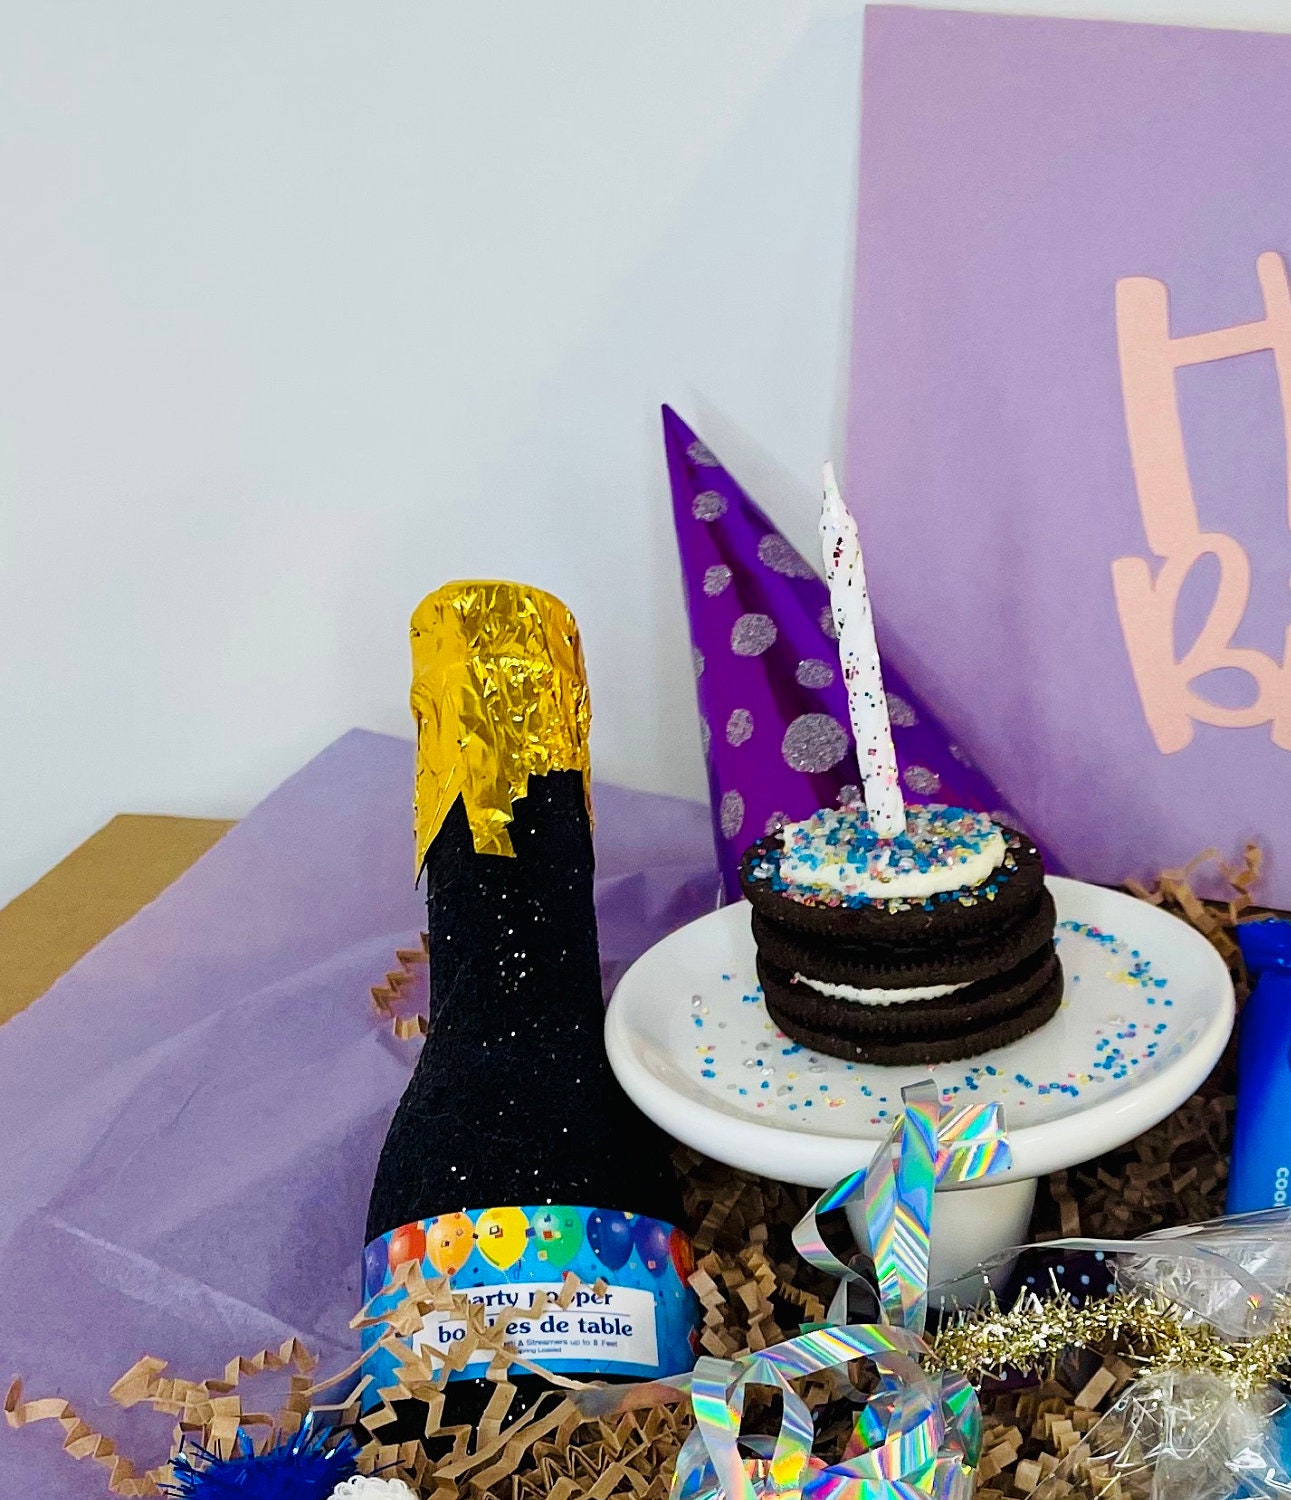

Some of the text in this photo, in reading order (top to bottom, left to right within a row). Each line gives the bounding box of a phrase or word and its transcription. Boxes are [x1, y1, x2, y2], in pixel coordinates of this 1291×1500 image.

[468, 1289, 613, 1308] arty poper
[438, 1316, 633, 1344] boes de table
